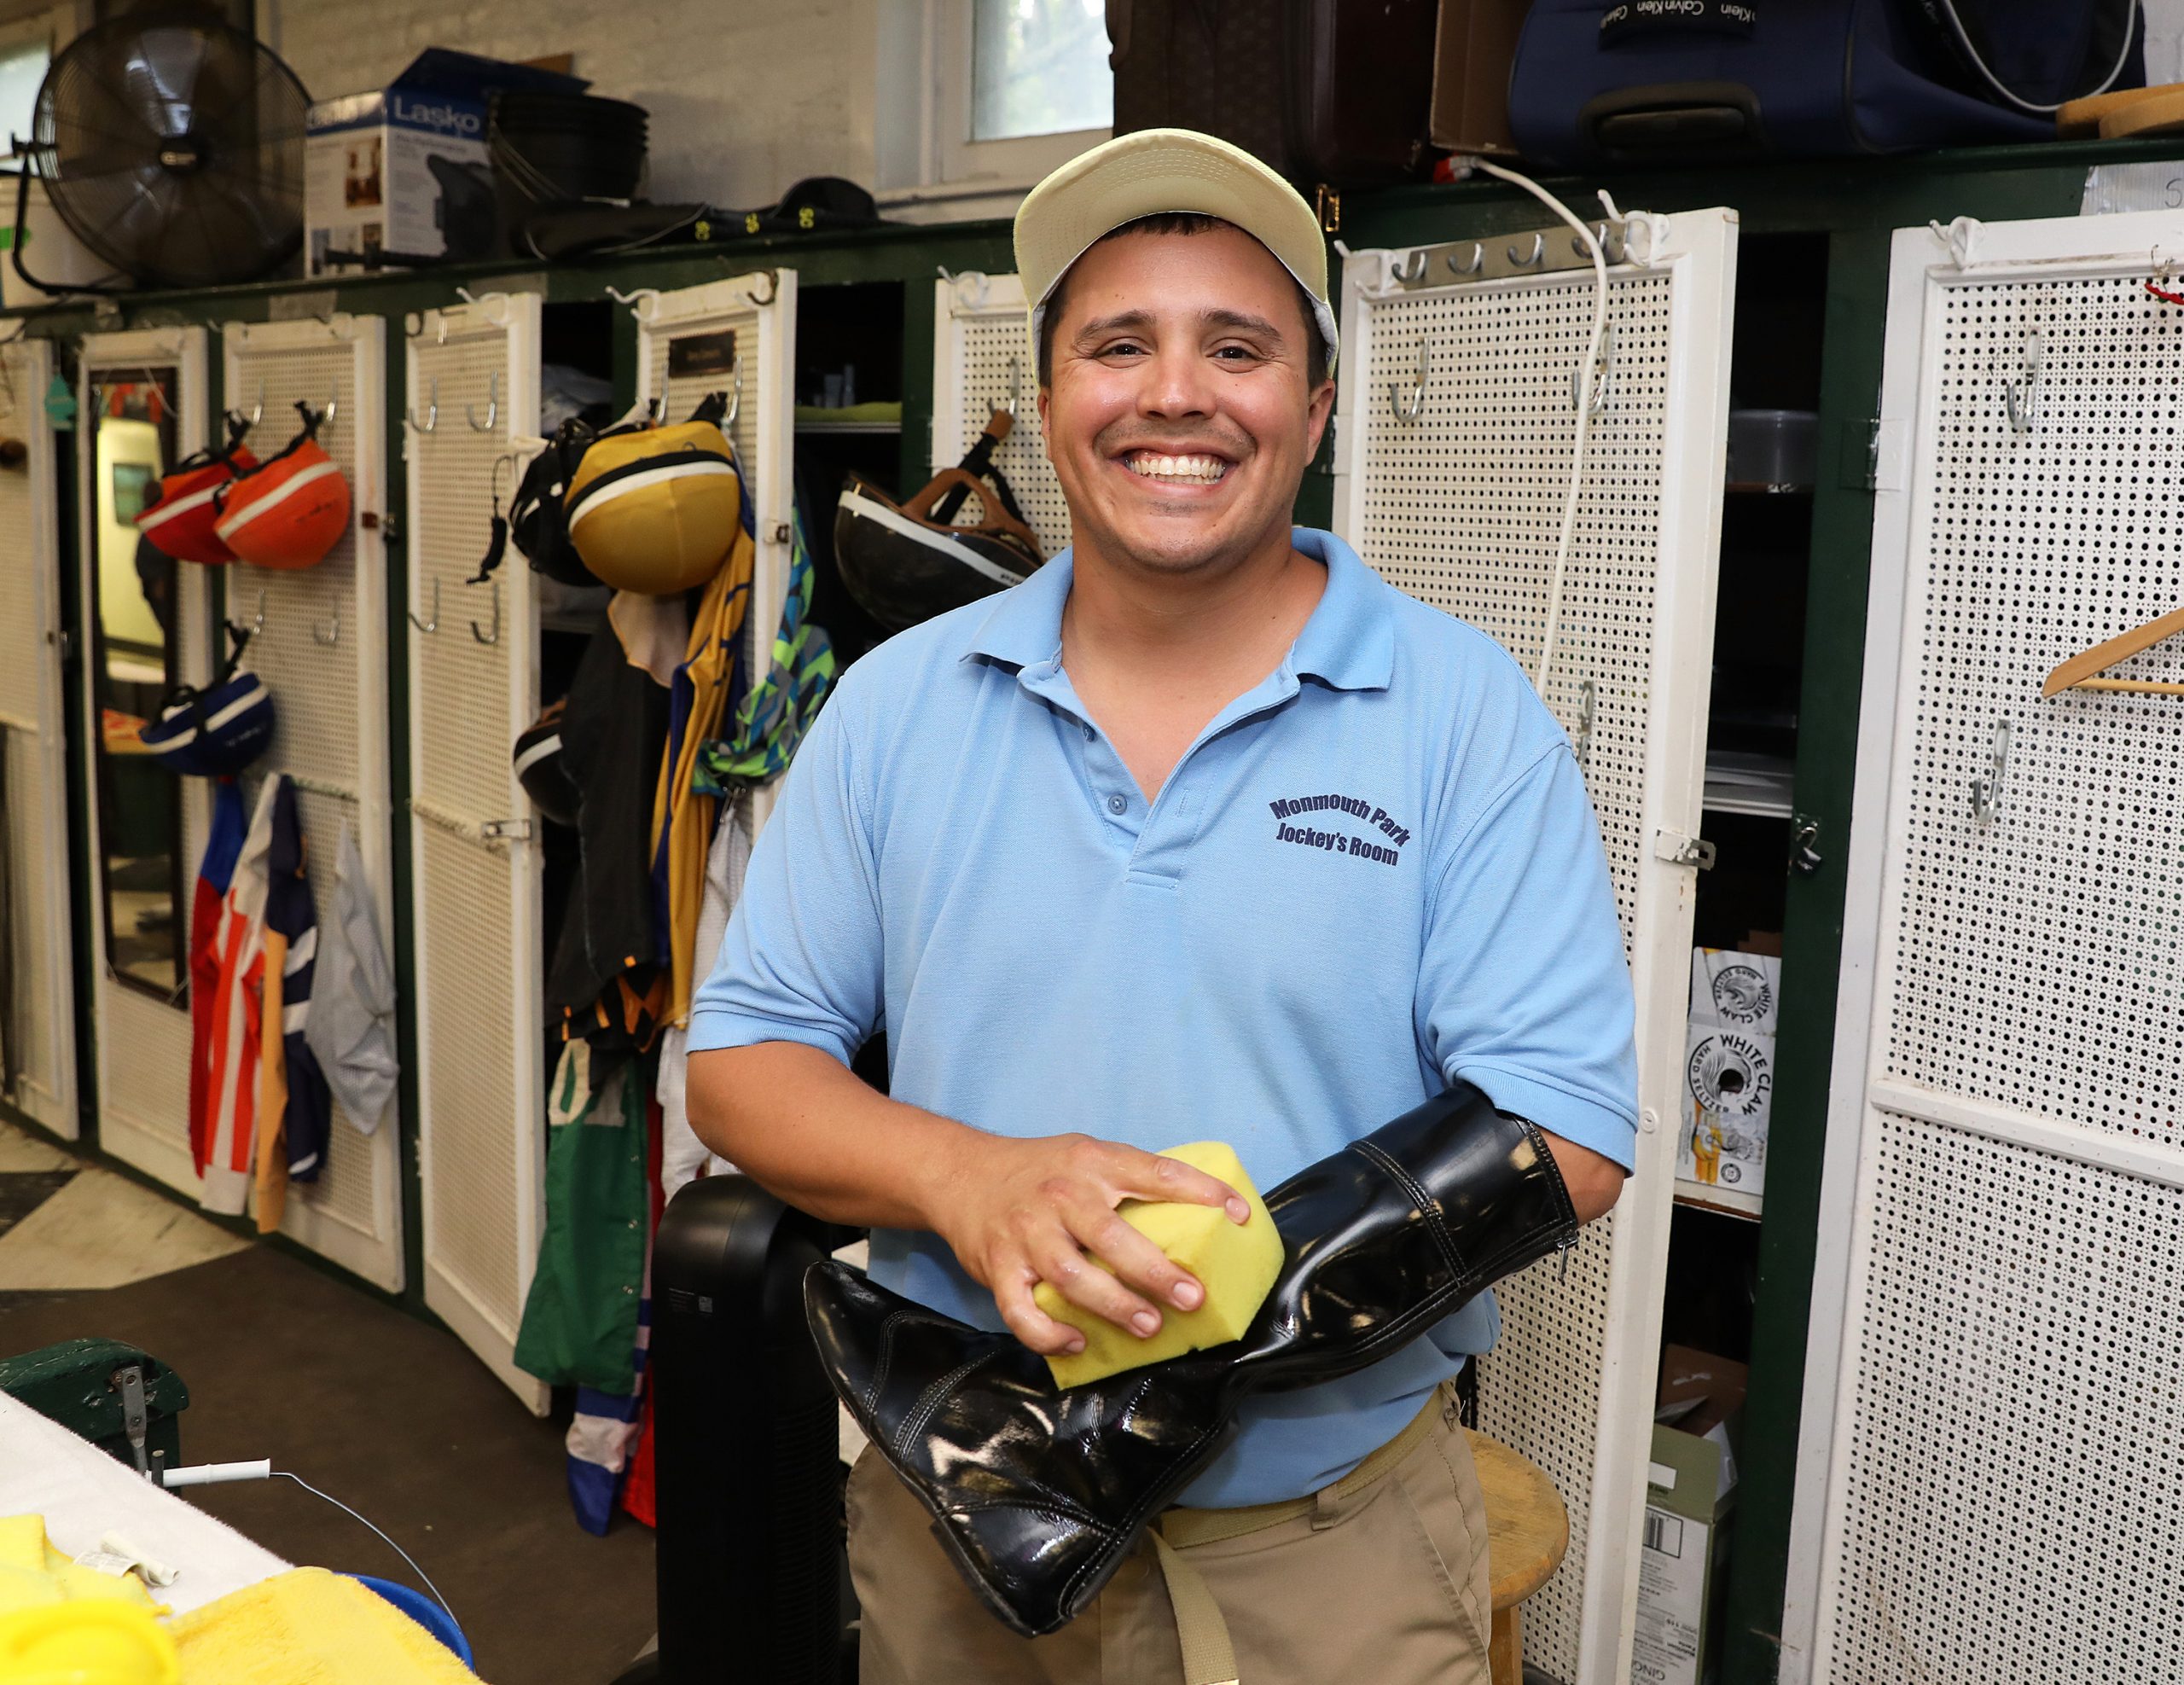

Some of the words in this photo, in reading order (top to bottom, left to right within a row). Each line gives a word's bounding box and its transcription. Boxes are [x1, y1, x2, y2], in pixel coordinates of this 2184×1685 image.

[1665, 0, 1705, 15] Calvin
[393, 95, 480, 133] Lasko
[1269, 794, 1371, 820] Monmouth
[1369, 807, 1410, 847] Park
[1275, 822, 1348, 852] Jockey's
[1349, 836, 1399, 866] Room
[1720, 1007, 1754, 1024] CLAW
[1753, 983, 1772, 1020] WHITE
[1693, 1044, 1711, 1072] HARD
[1720, 1034, 1768, 1069] WHITE
[1693, 1078, 1729, 1113] SELTZER
[1741, 1073, 1771, 1115] CLAW
